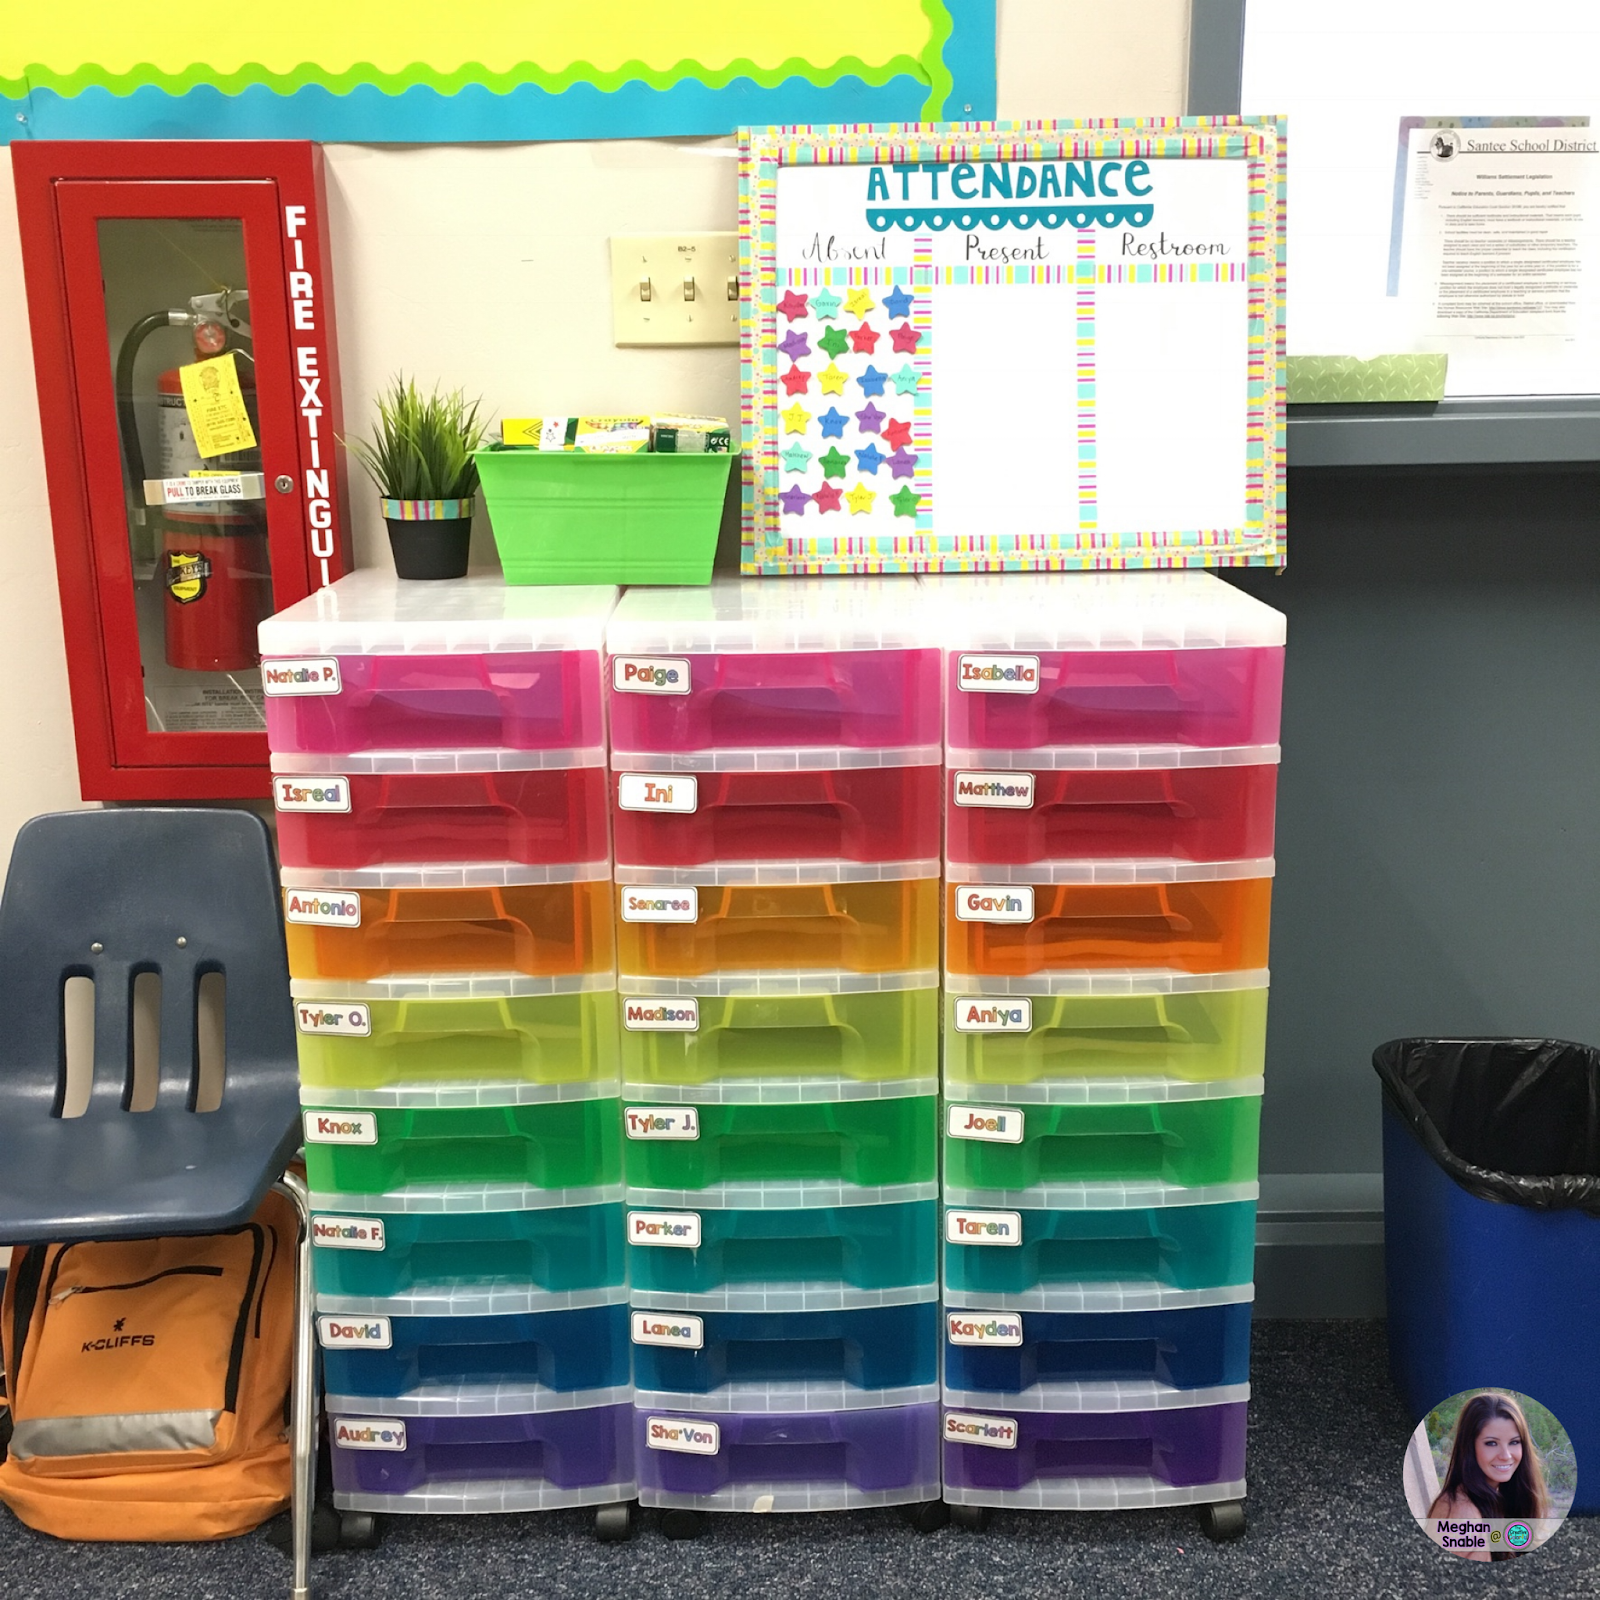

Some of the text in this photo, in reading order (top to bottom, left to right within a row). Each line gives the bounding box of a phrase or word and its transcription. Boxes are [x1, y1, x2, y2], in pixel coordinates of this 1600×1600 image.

[1467, 139, 1597, 151] Santee School District
[966, 234, 1051, 264] Present
[1122, 232, 1231, 260] Restroom
[285, 206, 315, 330] FIRE
[167, 484, 241, 497] PULL TO BREAK GLASS
[266, 666, 336, 684] Natalie P.
[624, 663, 679, 686] Paige
[962, 664, 1035, 681] Isabella
[282, 784, 341, 803] Isreal
[644, 783, 673, 804] Ini
[958, 781, 1029, 797] Matthew
[289, 896, 357, 917] Antonio
[967, 893, 1022, 912] Gavin
[300, 1009, 366, 1027] Tyler O.
[627, 1006, 696, 1022] Madison
[967, 1006, 1022, 1026] Aniya
[317, 1118, 363, 1135] Knox
[628, 1114, 696, 1133] Tyler J.
[964, 1114, 1006, 1132] Joell
[314, 1223, 383, 1241] Natalie F.
[635, 1220, 692, 1236] Parker
[957, 1217, 1010, 1236] Taren
[329, 1322, 381, 1339] David
[642, 1320, 691, 1338] Lanea
[951, 1320, 1020, 1339] Kayden
[81, 1334, 156, 1353] K-CLIFFS
[337, 1425, 404, 1445] Audrey
[947, 1419, 1013, 1439] Scarlett
